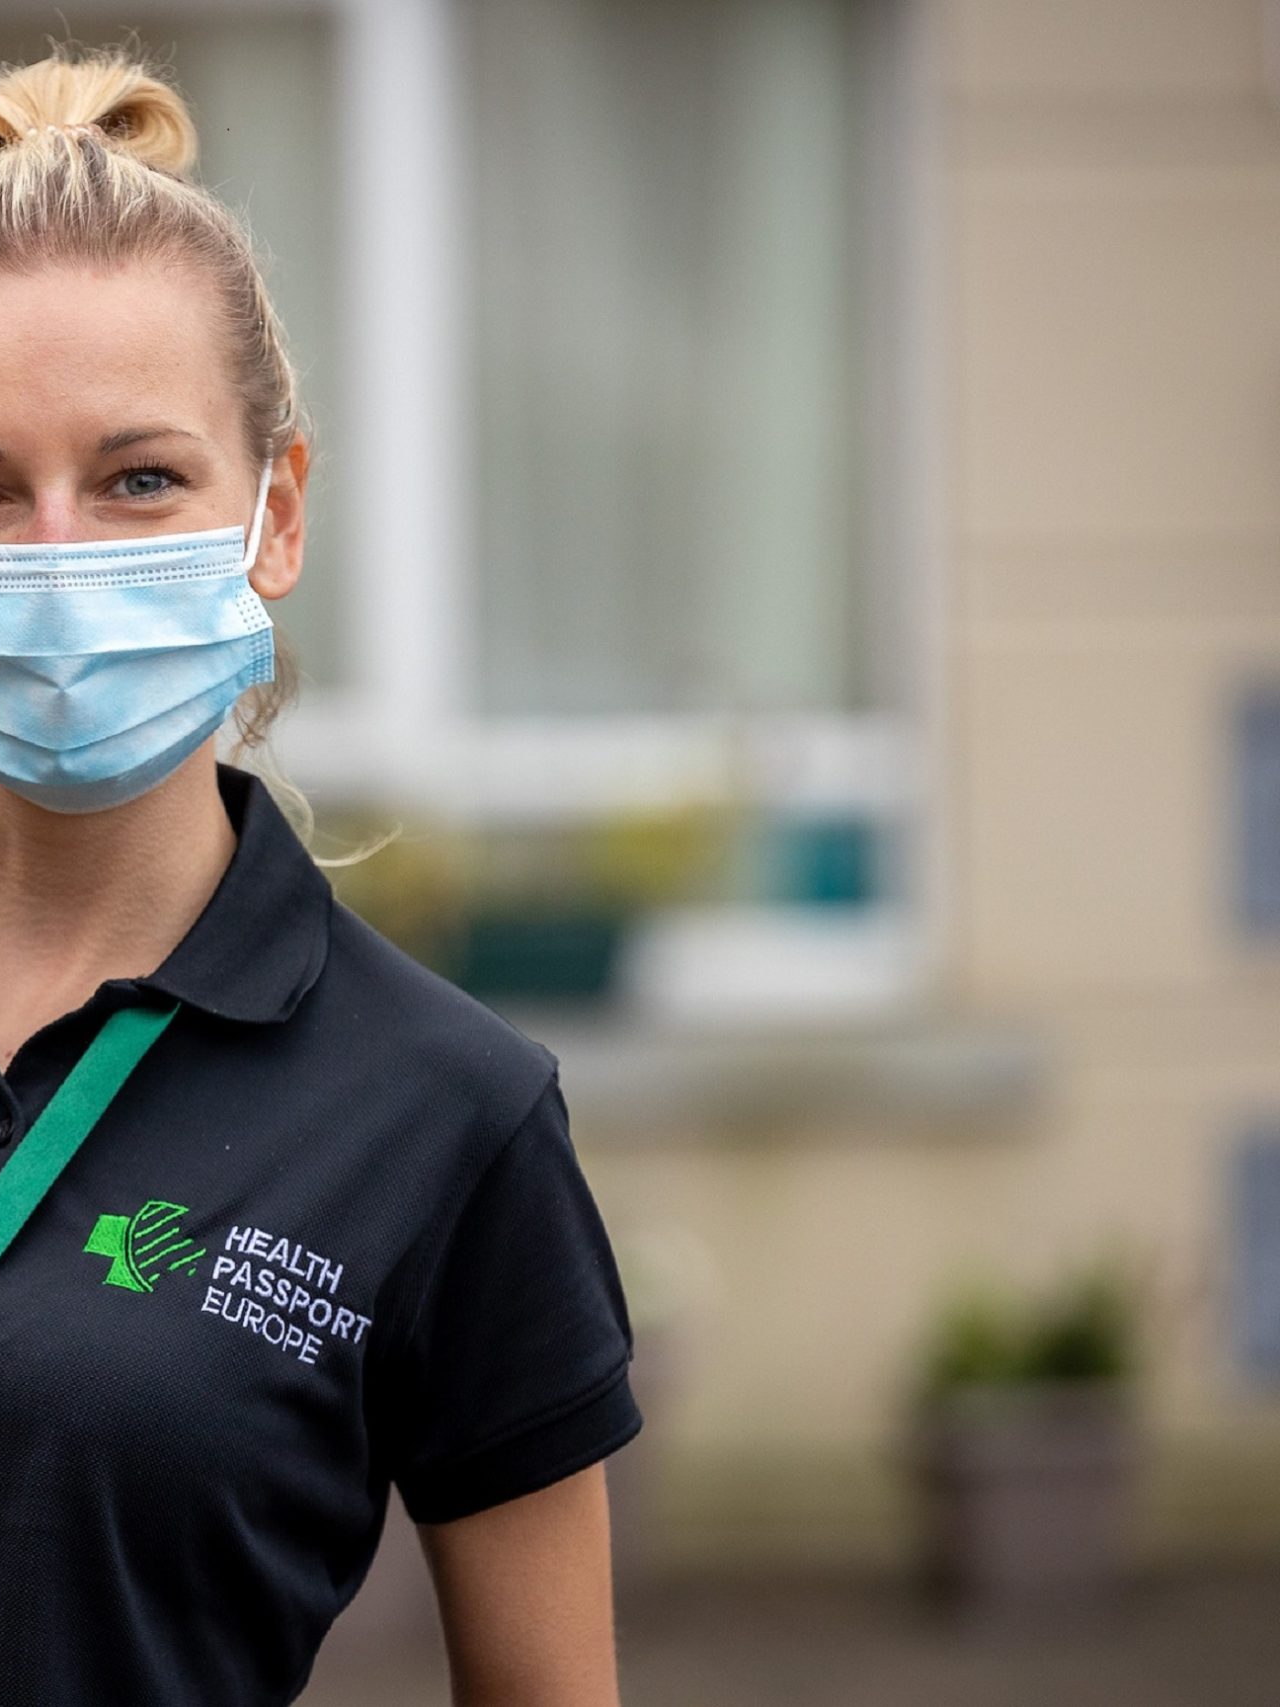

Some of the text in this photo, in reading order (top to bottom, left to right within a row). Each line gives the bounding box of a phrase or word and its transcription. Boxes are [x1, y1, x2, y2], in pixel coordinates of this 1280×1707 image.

[212, 1255, 372, 1344] PASSPORT
[225, 1226, 343, 1294] HEALTH
[201, 1286, 323, 1365] EUROPE
